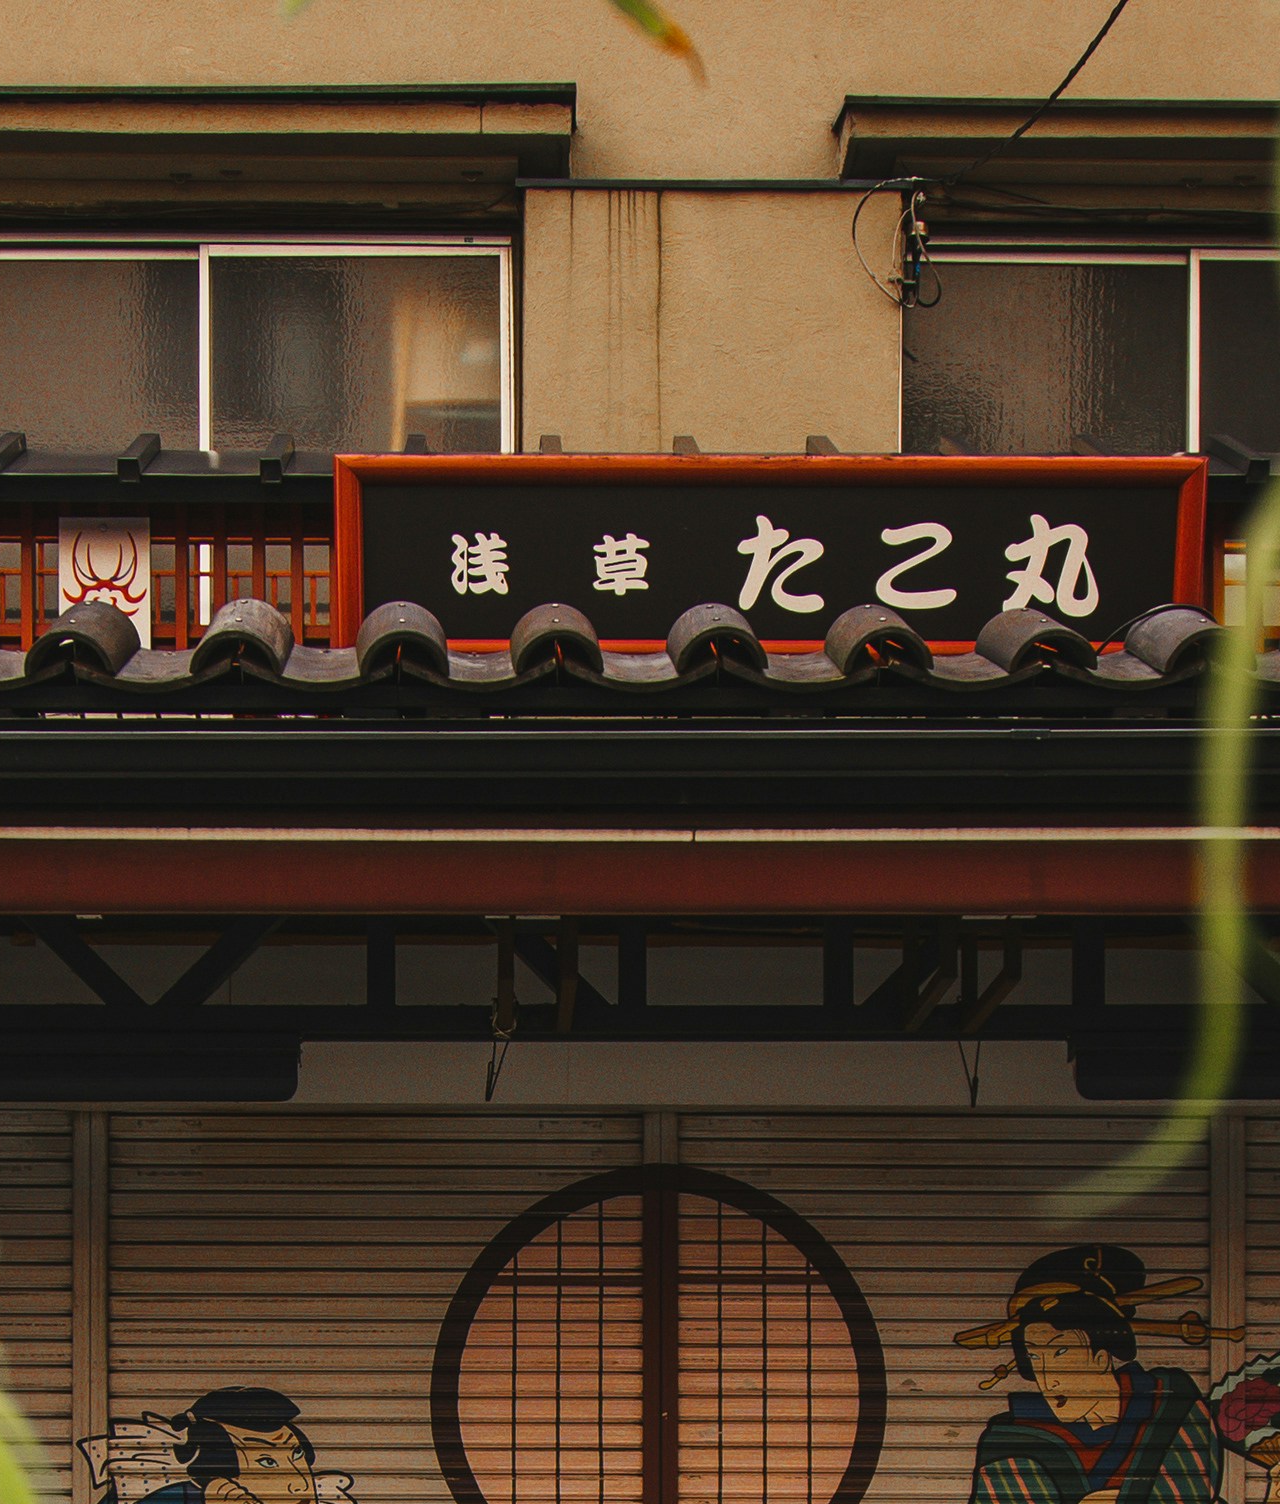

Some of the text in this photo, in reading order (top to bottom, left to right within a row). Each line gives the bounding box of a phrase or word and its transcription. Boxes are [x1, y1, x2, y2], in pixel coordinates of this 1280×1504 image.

[451, 513, 1100, 618] 浅草 たこ丸
